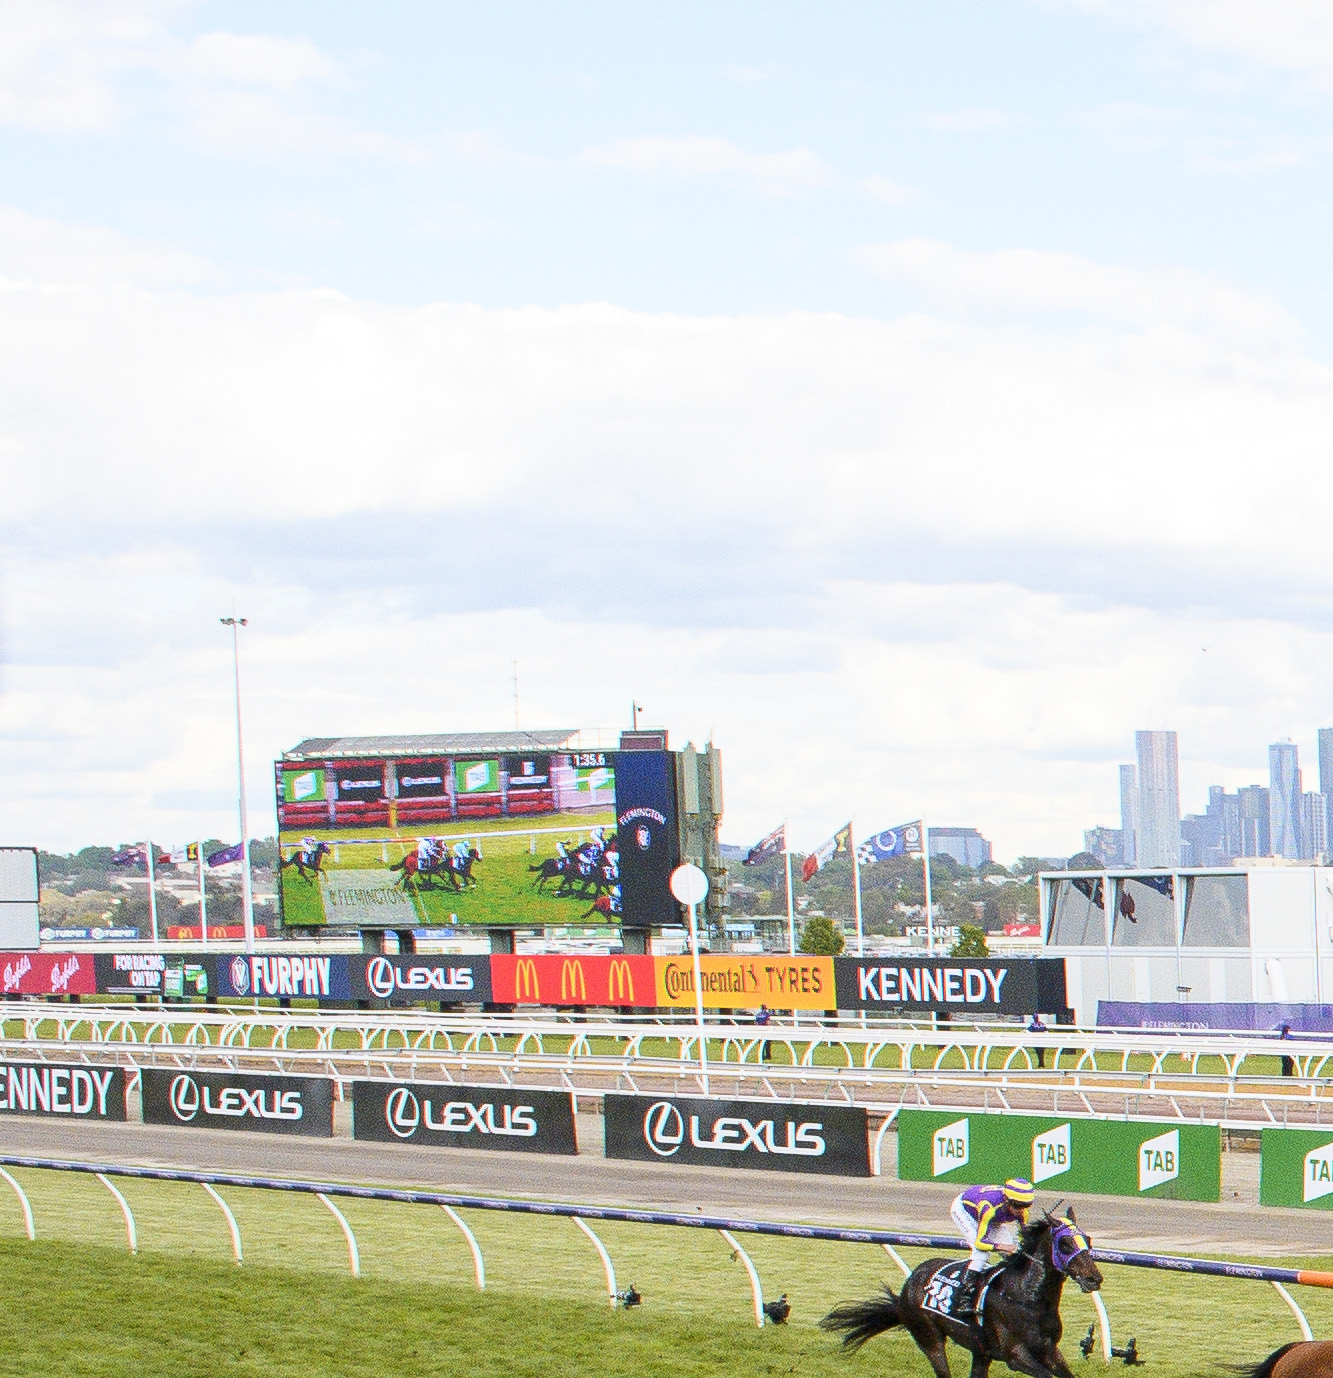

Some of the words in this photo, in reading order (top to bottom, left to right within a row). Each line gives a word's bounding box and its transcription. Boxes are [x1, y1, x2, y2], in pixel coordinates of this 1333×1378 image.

[249, 956, 330, 996] FURPHY
[394, 967, 474, 991] LEXUS
[664, 963, 746, 999] Contnental
[764, 966, 821, 995] TYRES
[857, 966, 1008, 1004] KENNEDY
[202, 1086, 303, 1121] LEXUS
[423, 1100, 538, 1137] LEXUS
[690, 1115, 826, 1156] LEXUS
[937, 1136, 966, 1160] TAB
[1037, 1142, 1067, 1166] TAB
[1143, 1147, 1175, 1173] TAB
